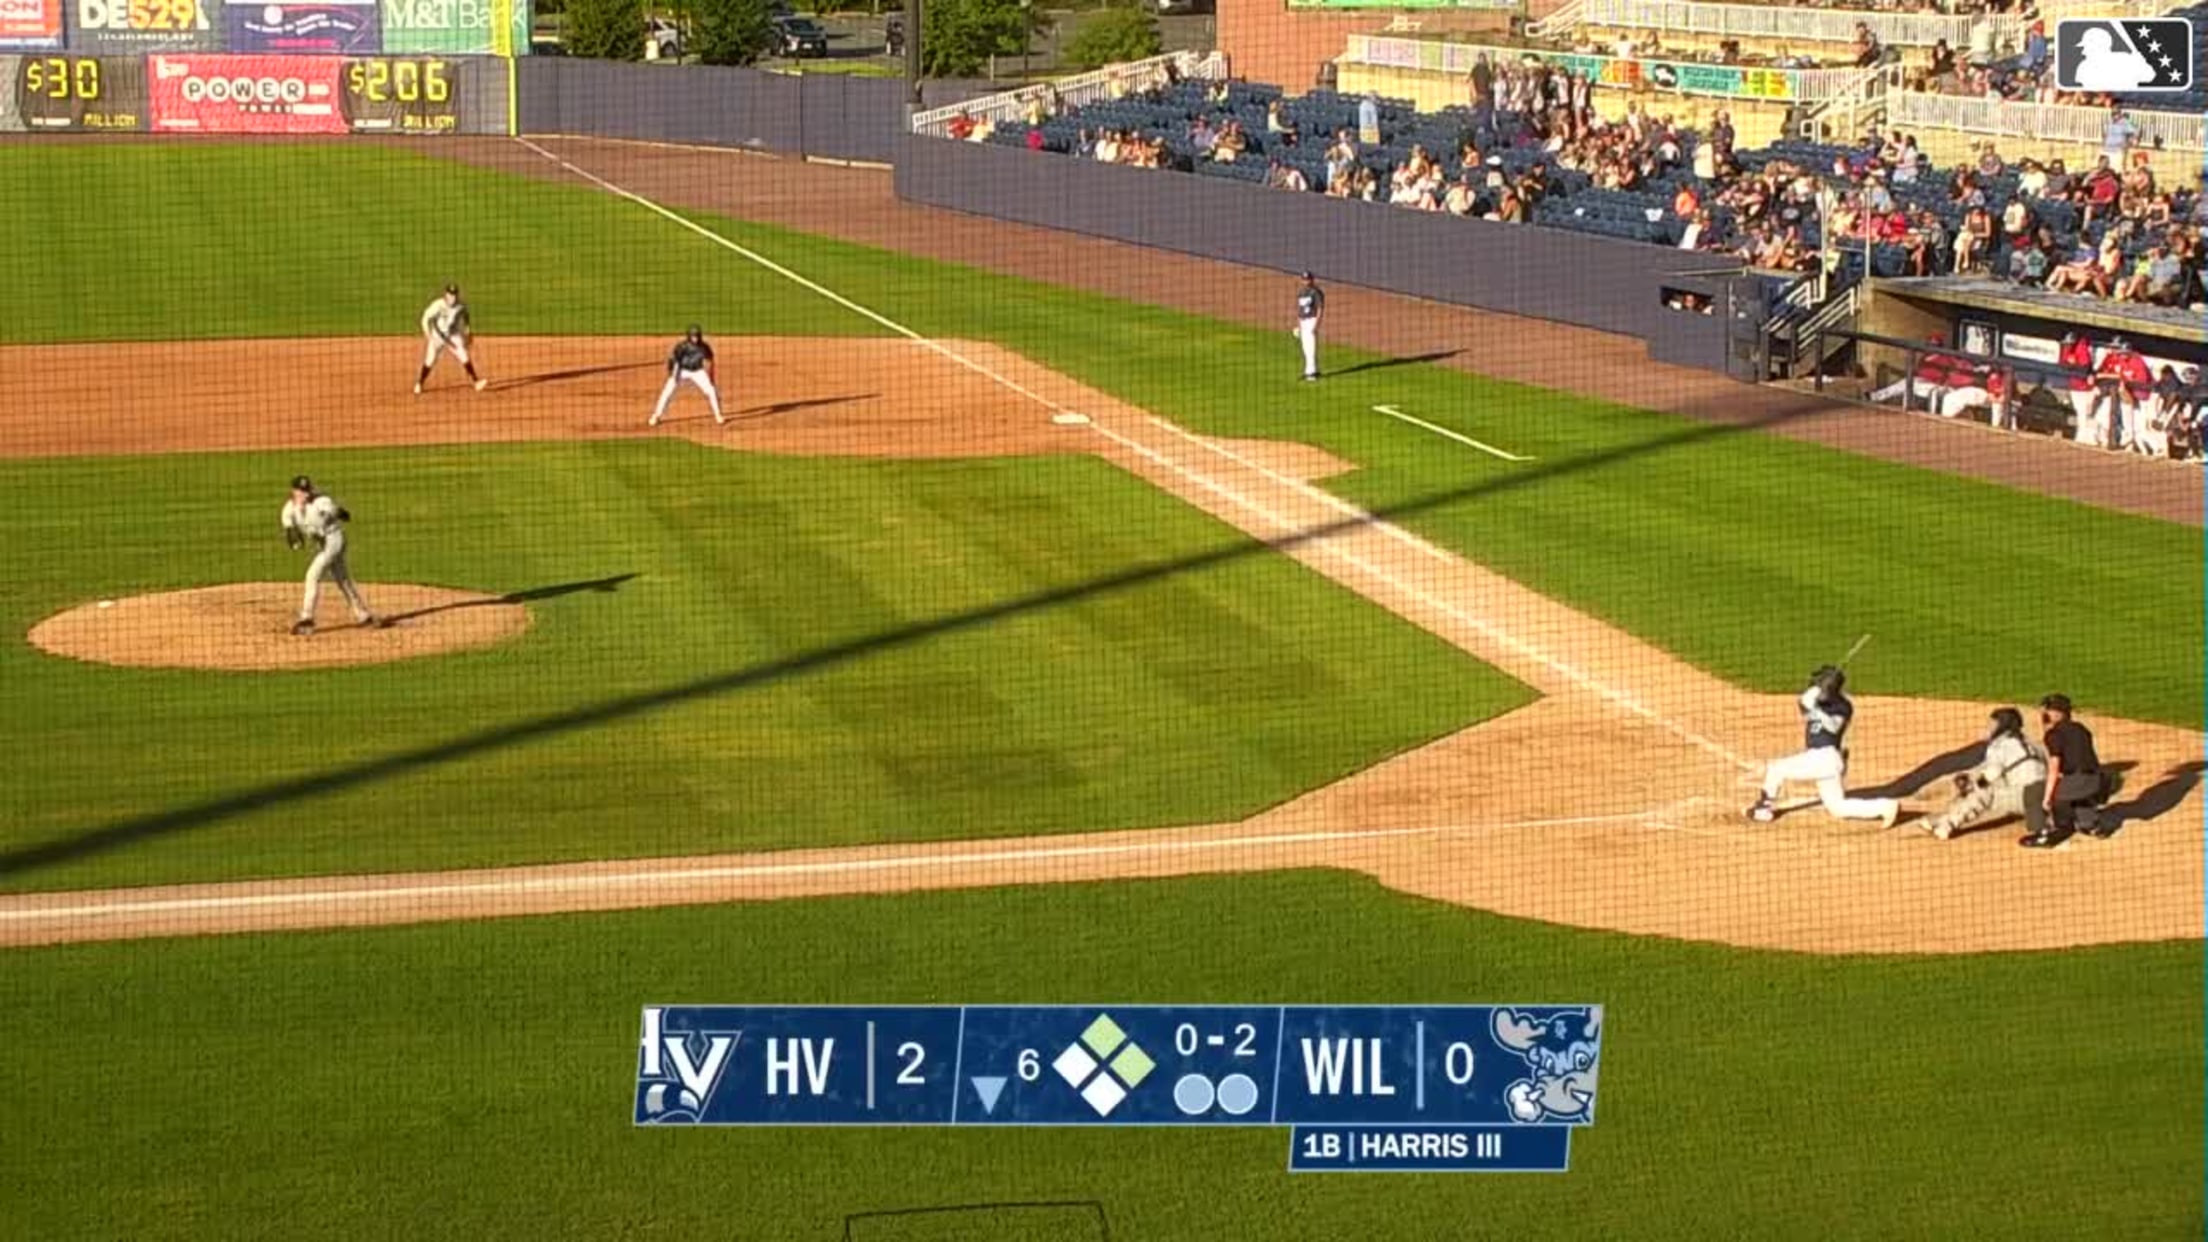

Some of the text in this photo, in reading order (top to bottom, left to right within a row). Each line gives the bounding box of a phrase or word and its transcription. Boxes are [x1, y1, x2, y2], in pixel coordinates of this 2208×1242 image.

[383, 0, 454, 28] M&T
[27, 58, 98, 98] $30
[185, 79, 303, 100] POWER
[350, 61, 448, 101] $206
